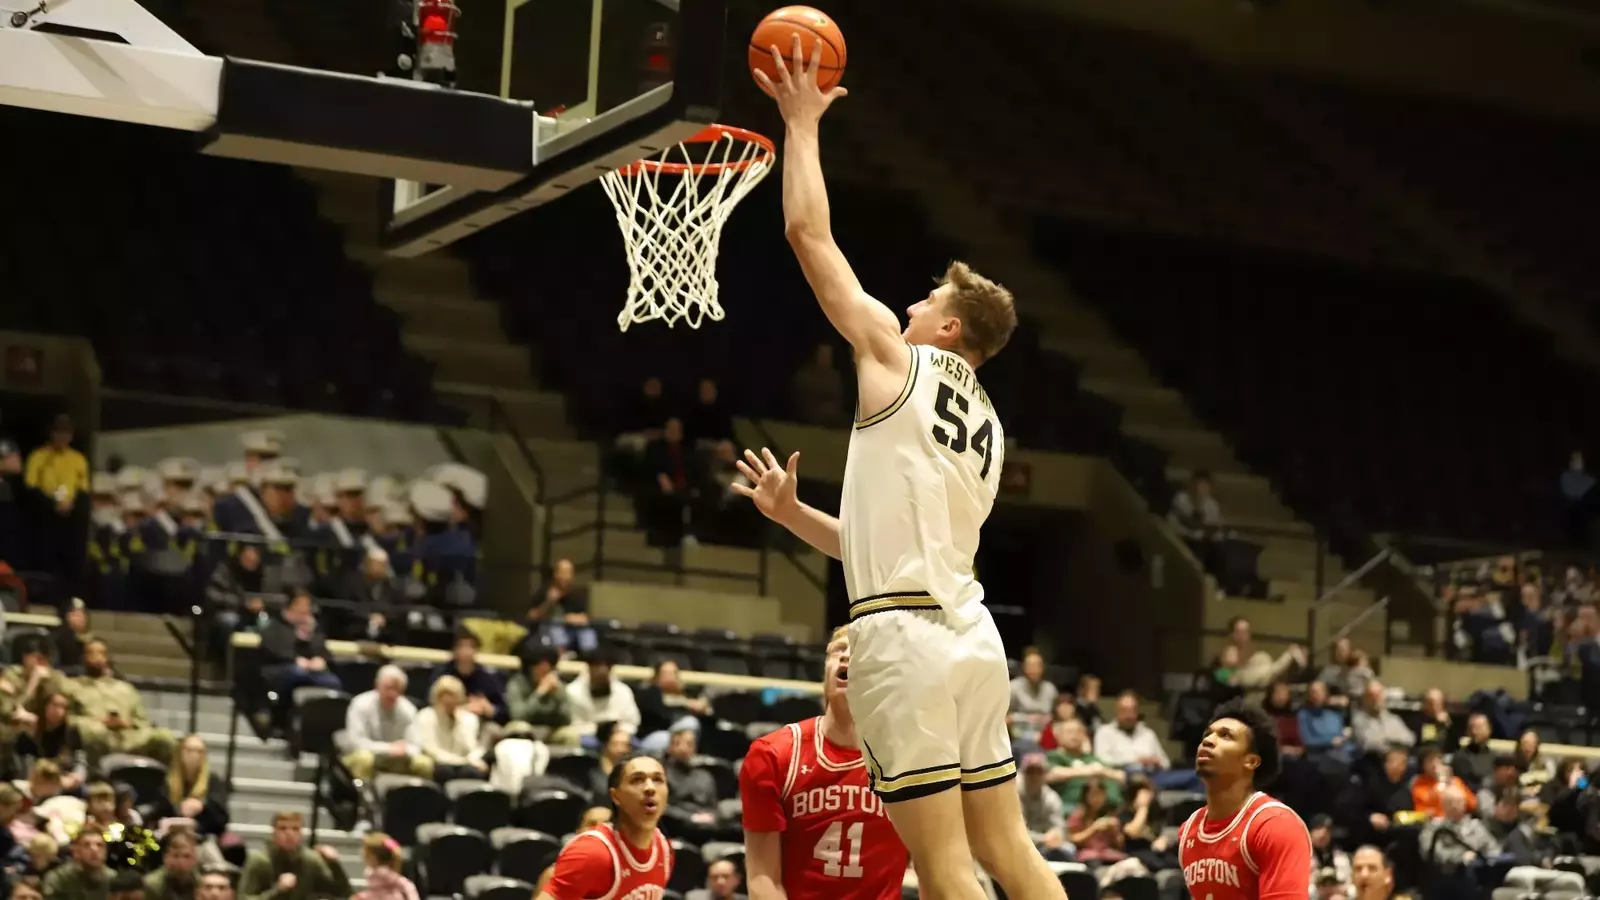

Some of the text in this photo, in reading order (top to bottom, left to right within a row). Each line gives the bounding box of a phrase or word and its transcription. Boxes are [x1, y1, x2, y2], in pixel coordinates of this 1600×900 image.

[930, 352, 971, 387] WEST
[931, 381, 993, 481] 54
[813, 821, 864, 878] 41
